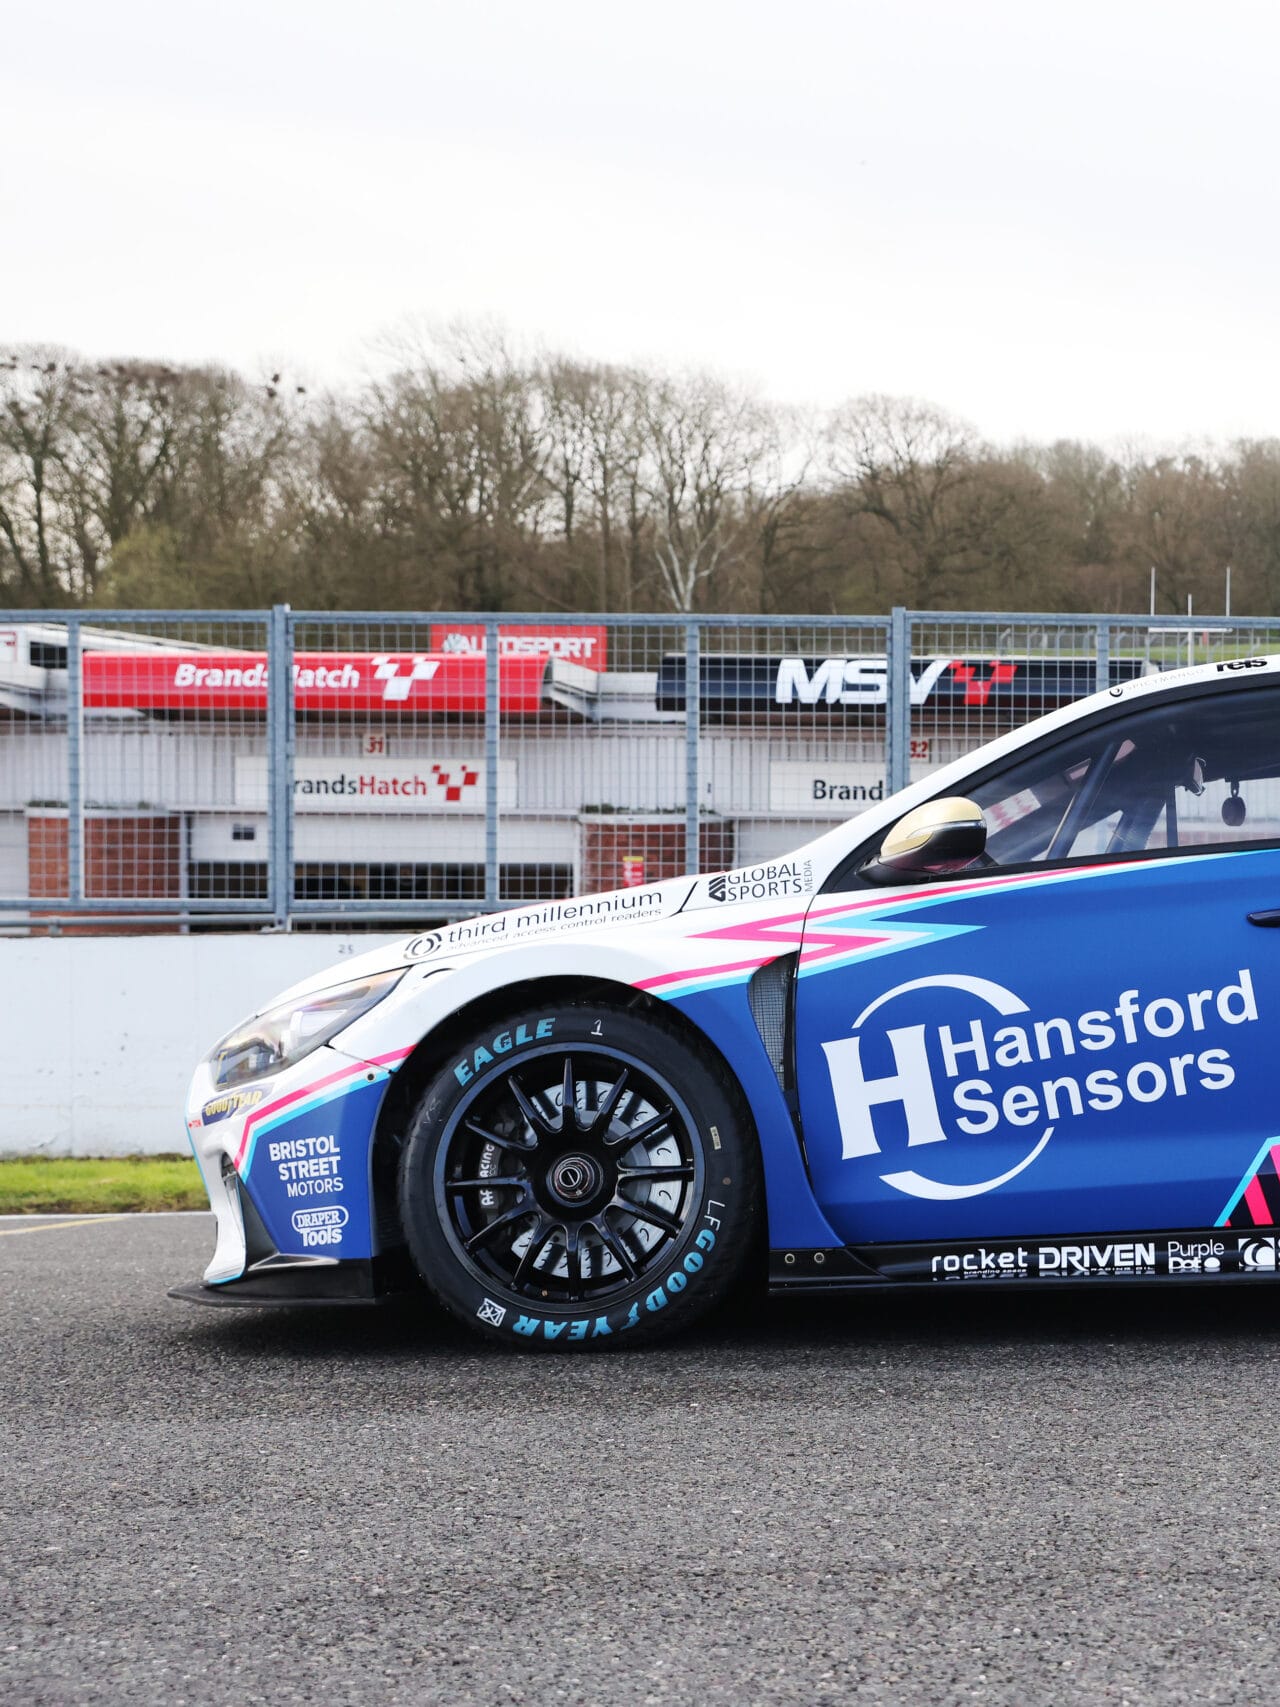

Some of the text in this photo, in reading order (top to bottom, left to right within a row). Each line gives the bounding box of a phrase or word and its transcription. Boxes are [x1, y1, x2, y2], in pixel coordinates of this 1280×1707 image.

[174, 664, 360, 688] Brandatch
[1216, 658, 1268, 672] reis
[776, 659, 951, 704] MSV
[293, 774, 427, 796] randsHatch
[813, 780, 884, 801] Brand
[728, 863, 802, 885] GLOBAL
[804, 860, 812, 892] MEDIA
[728, 879, 802, 901] SPORTS
[448, 891, 663, 943] third millennium
[513, 926, 557, 938] access
[561, 916, 607, 931] control
[612, 907, 663, 922] readers
[590, 1019, 604, 1037] 1
[938, 969, 1259, 1078] Hansford
[453, 1017, 556, 1087] EAGLE
[822, 1024, 948, 1161] H
[955, 1048, 1236, 1135] Sensors
[269, 1135, 340, 1161] BRISTOL
[279, 1156, 341, 1181] STREET
[287, 1177, 344, 1198] MOTORS
[296, 1210, 342, 1229] DRAPER
[300, 1225, 343, 1247] Tools
[1168, 1239, 1225, 1258] Purple
[931, 1247, 1028, 1273] rocket
[1039, 1243, 1155, 1271] DRIVEN
